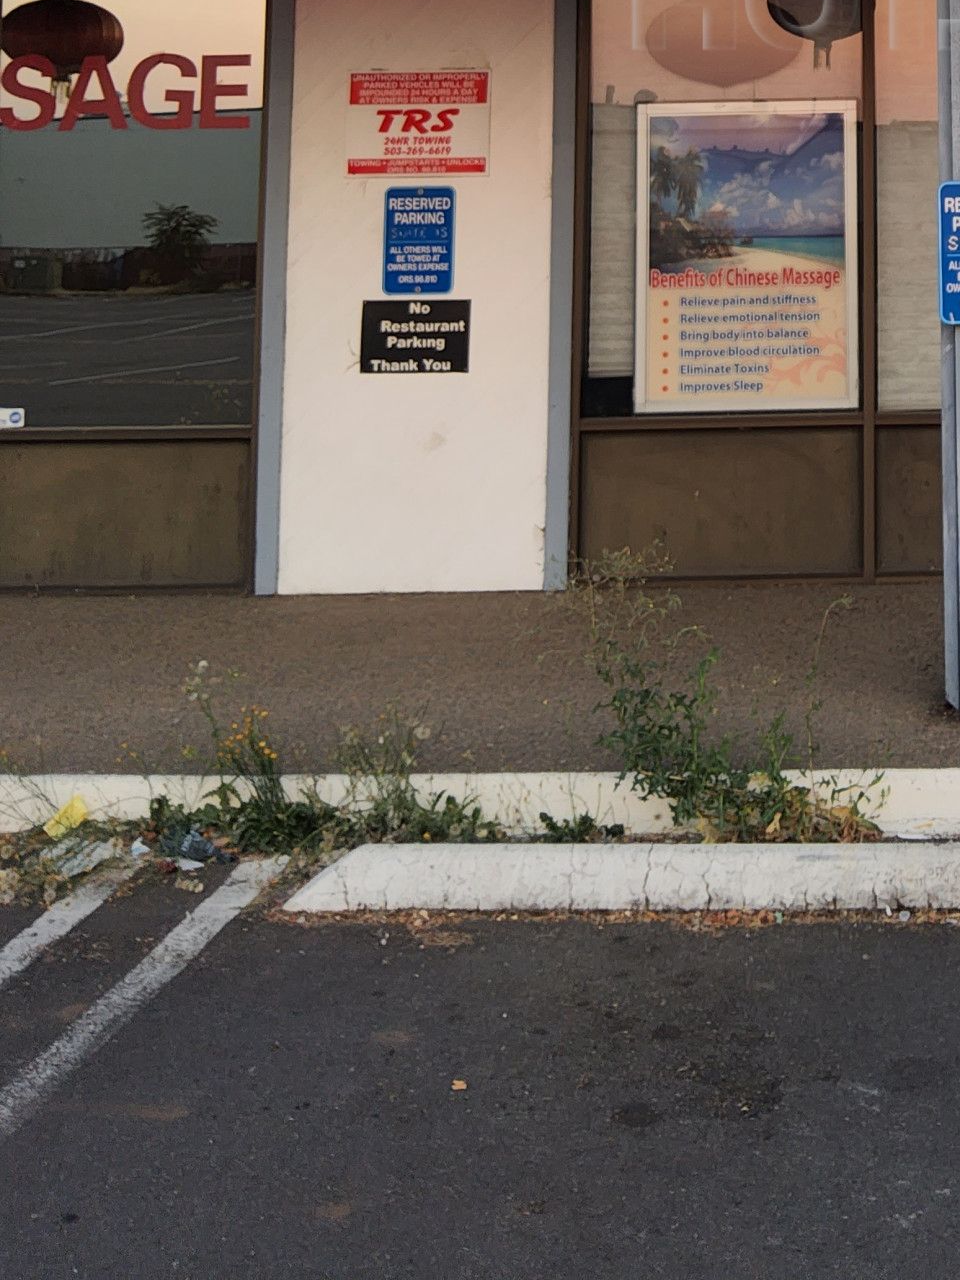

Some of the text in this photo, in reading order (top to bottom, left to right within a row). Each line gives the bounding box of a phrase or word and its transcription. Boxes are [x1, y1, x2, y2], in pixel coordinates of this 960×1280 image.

[352, 72, 486, 82] UNAUTHORIZED OR IMPROPERLY
[364, 80, 475, 89] PARKED VEHICLES WILL BE
[0, 53, 251, 131] SAGE
[360, 88, 409, 96] IMPOUNDED
[422, 88, 452, 96] HOURS
[453, 88, 460, 96] A
[461, 88, 479, 96] DAY
[359, 96, 372, 104] AT
[372, 96, 409, 104] OWNERS
[410, 96, 430, 104] RISK
[438, 96, 478, 104] EXPENSE
[376, 108, 460, 134] TRS
[384, 136, 452, 146] 24HR TOWING
[389, 197, 451, 210] RESERVED
[394, 212, 445, 225] PARKING
[390, 246, 448, 254] ALL OTHERS WILL
[407, 254, 432, 262] TOWED
[432, 254, 440, 262] AT
[387, 262, 450, 272] OWNERS EXPENSE
[651, 267, 841, 290] Benefits of Chinese Massage
[680, 294, 817, 308] Relieve pain and stiffness
[408, 302, 431, 315] No
[680, 311, 820, 324] Relieve emotional tension
[380, 320, 466, 333] Restaurant
[680, 328, 809, 343] Bring body into balance
[386, 336, 446, 350] Parking
[680, 345, 820, 359] Improve blood circulation
[370, 358, 452, 372] Thank You
[680, 363, 770, 374] Eliminate Toxins
[680, 380, 764, 393] Improves Sleep
